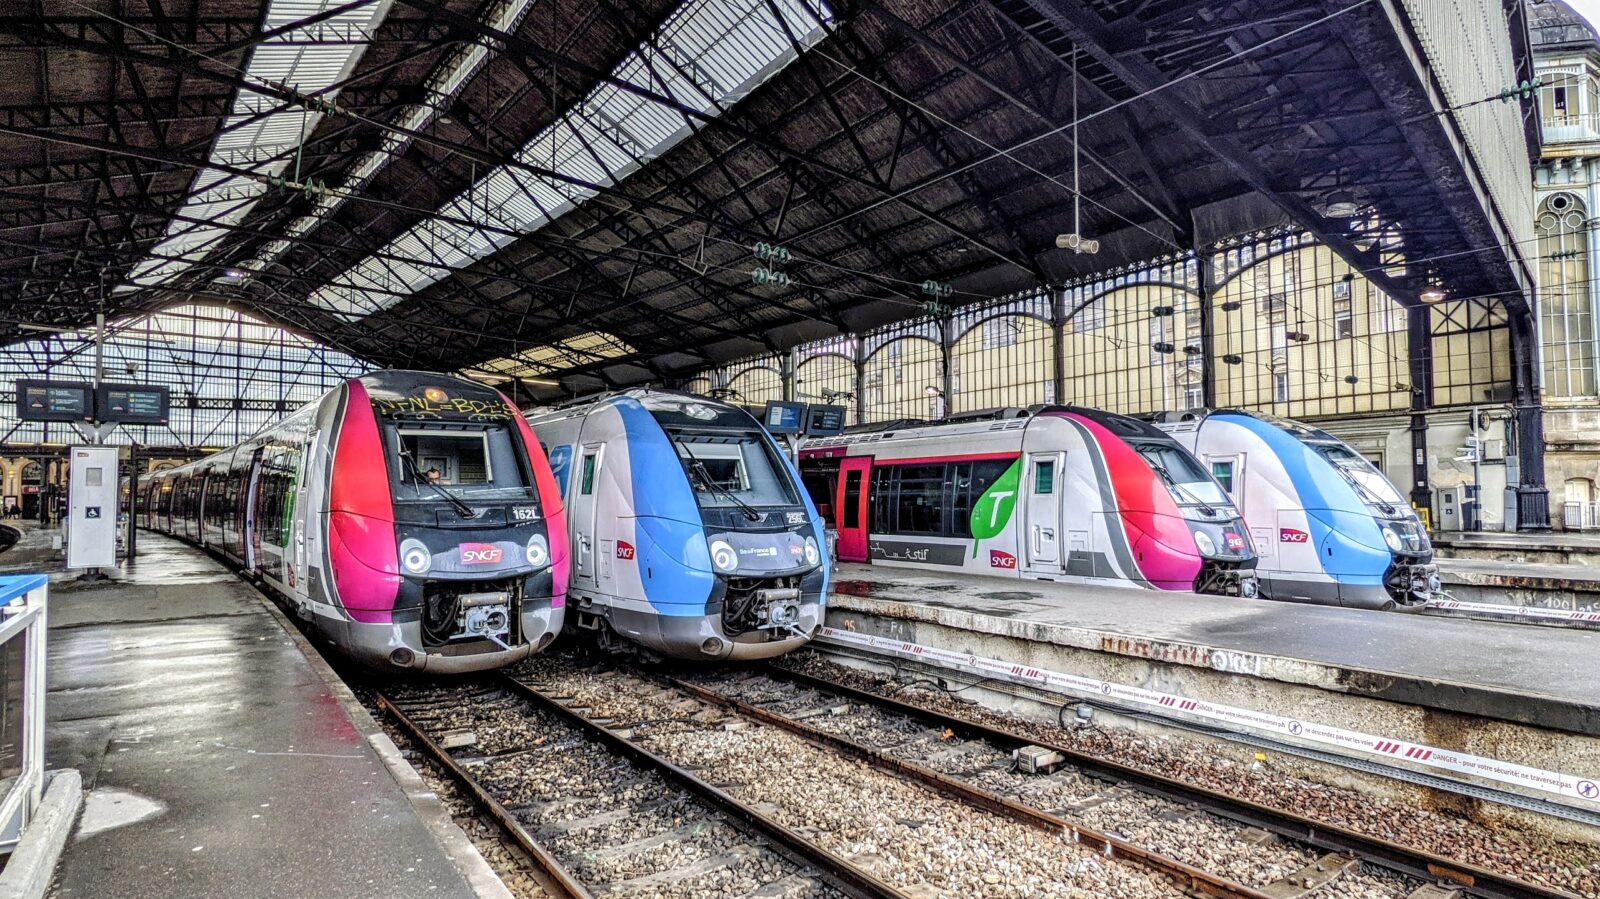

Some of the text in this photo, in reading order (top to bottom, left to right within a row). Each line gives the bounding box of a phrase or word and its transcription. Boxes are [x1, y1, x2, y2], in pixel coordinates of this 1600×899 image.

[513, 509, 541, 520] 162L
[989, 491, 1014, 528] T
[1281, 533, 1307, 541] SNCF
[463, 550, 500, 562] SNCF
[617, 547, 633, 558] SNCF
[913, 548, 929, 560] stif
[991, 556, 1016, 567] SNCF
[1311, 728, 1335, 738] descendez
[1352, 736, 1360, 744] les
[1360, 738, 1374, 747] voies
[1432, 753, 1458, 764] DANGER
[1462, 760, 1476, 769] pour
[1477, 763, 1493, 772] votre
[1493, 765, 1520, 778] sécurité:
[1530, 774, 1560, 785] traversez
[1560, 781, 1572, 789] pas
